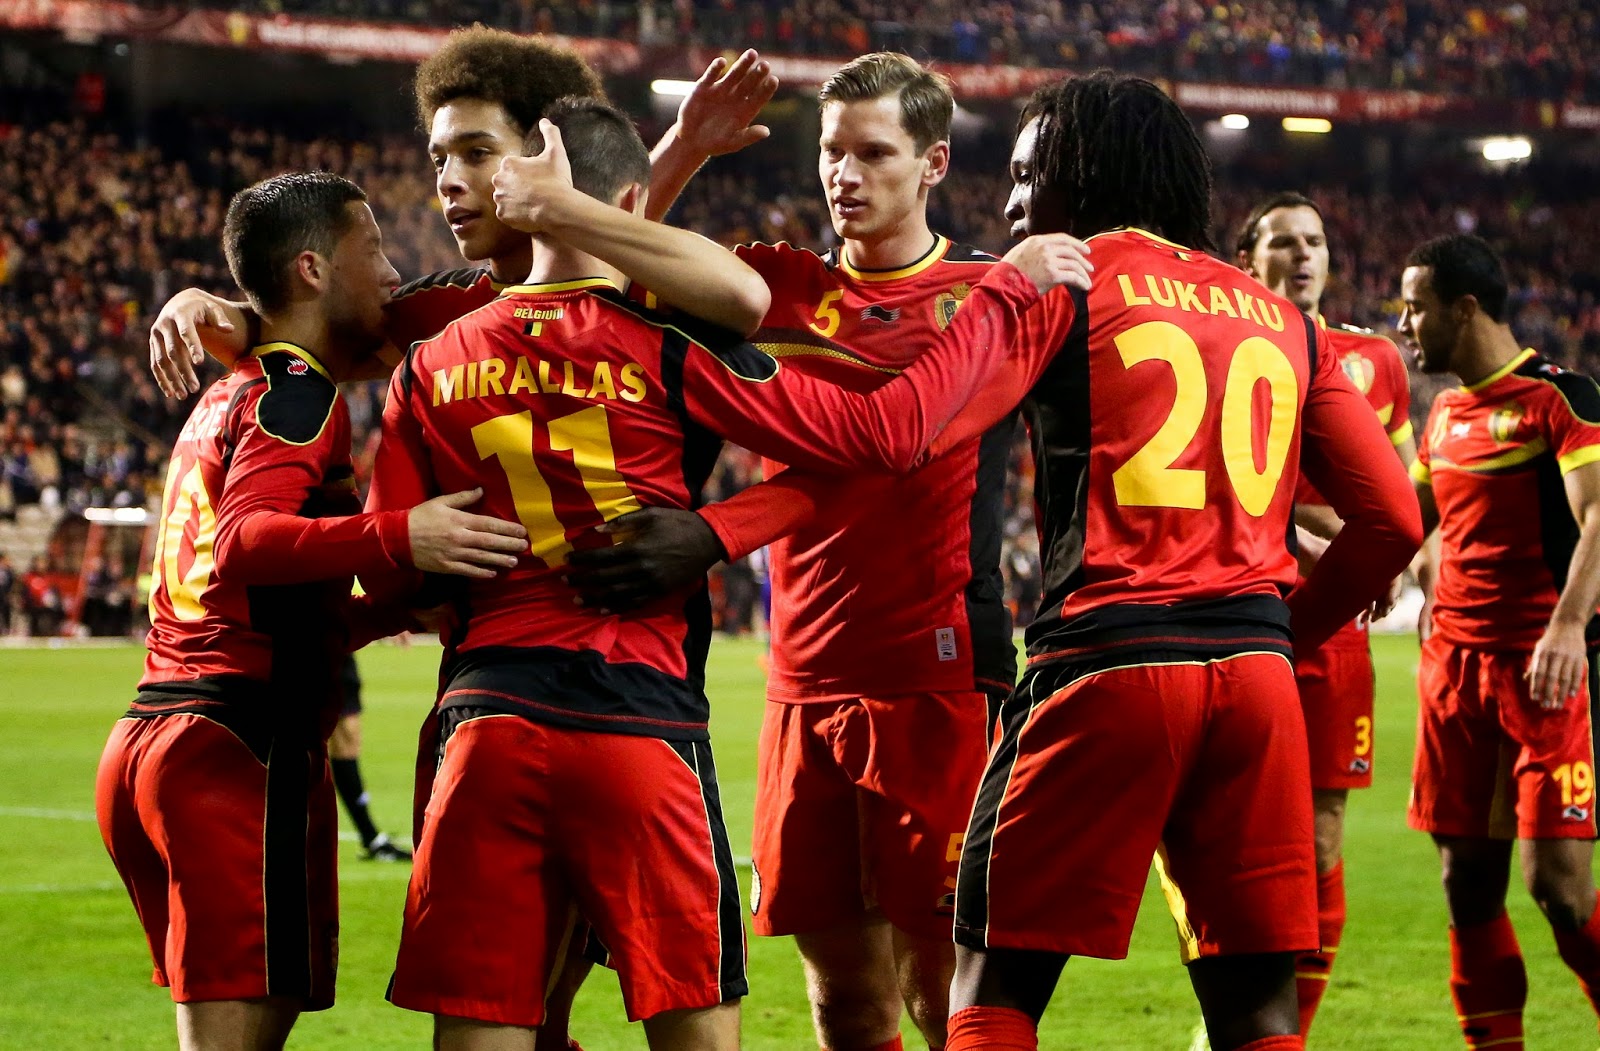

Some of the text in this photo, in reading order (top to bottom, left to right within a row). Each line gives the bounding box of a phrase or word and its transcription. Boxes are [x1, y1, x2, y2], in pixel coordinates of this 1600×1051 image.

[513, 306, 565, 321] BELGIUM
[808, 288, 845, 339] 5
[1116, 273, 1285, 333] LUKAKU
[432, 354, 648, 408] MIRALLAS
[1111, 319, 1299, 518] 20
[470, 403, 643, 569] 11
[1354, 715, 1372, 756] 3
[1551, 760, 1594, 805] 19
